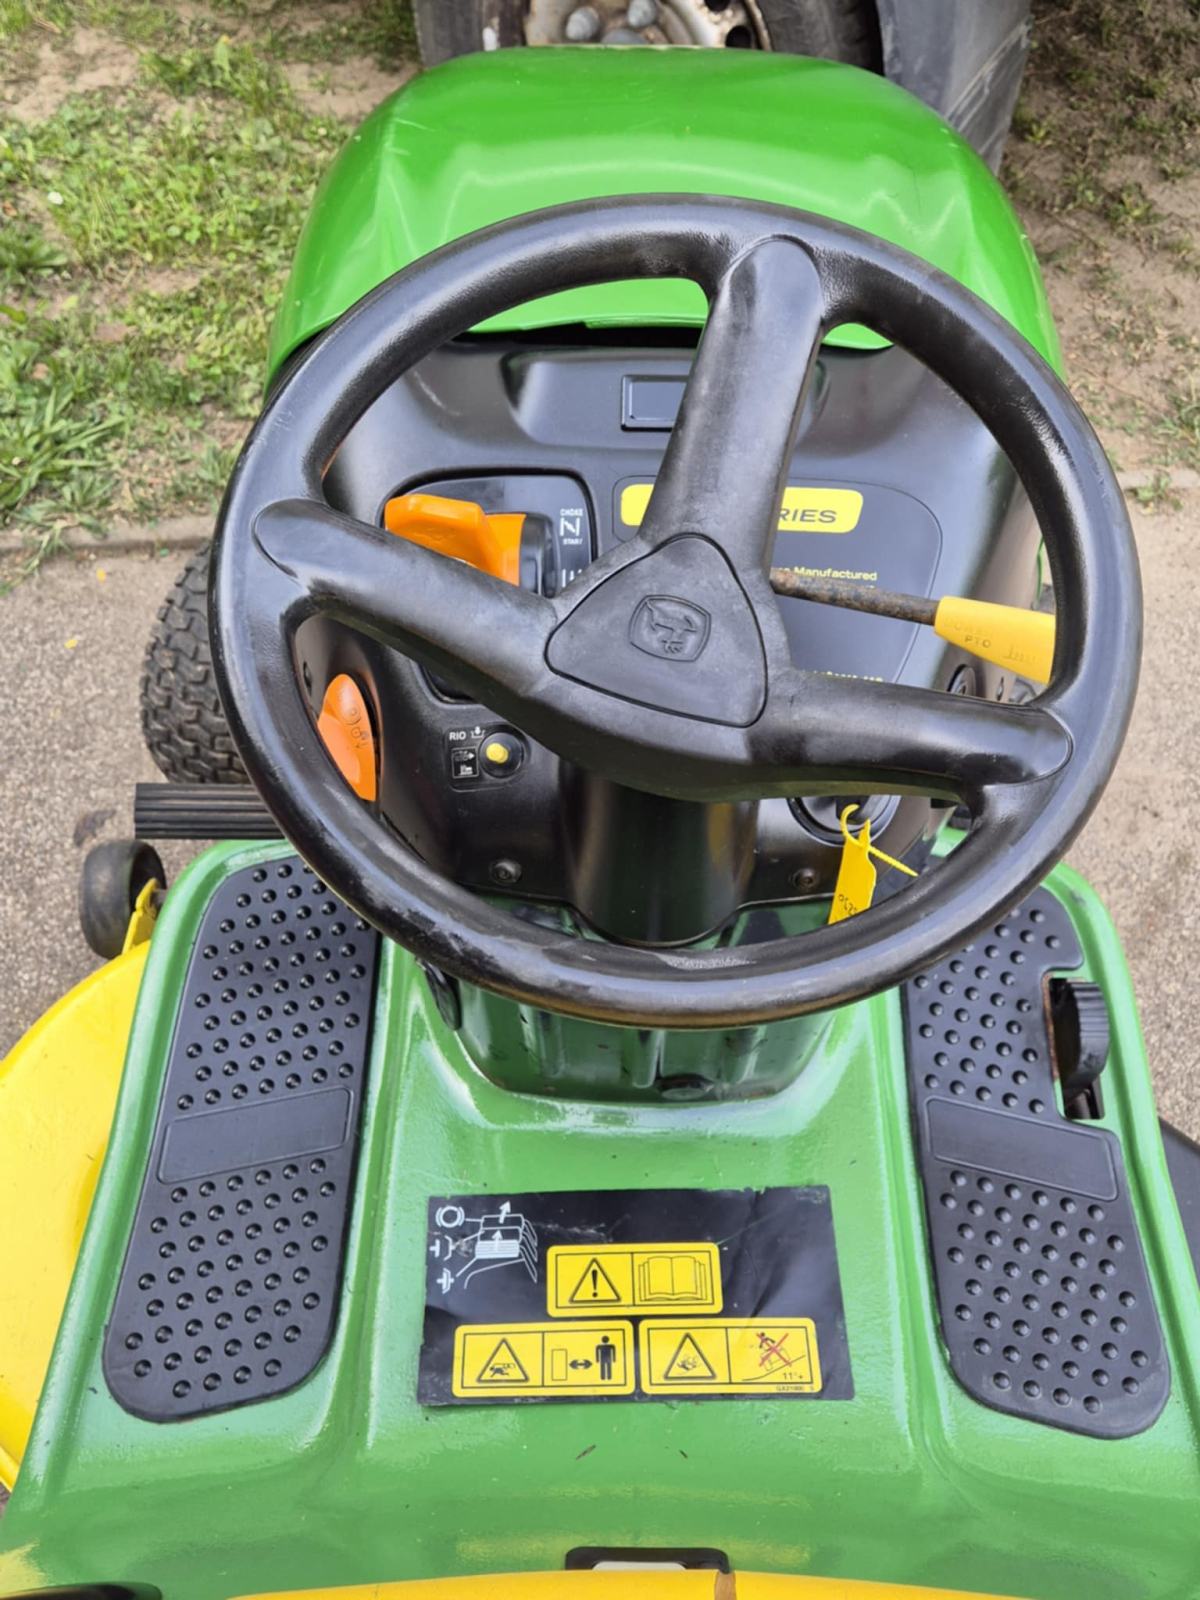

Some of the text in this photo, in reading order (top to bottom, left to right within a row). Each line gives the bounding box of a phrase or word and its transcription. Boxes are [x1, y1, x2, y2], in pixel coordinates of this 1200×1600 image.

[779, 508, 838, 523] RIES
[793, 566, 877, 581] Manufactured
[964, 634, 992, 649] PTO
[449, 731, 467, 741] RIO
